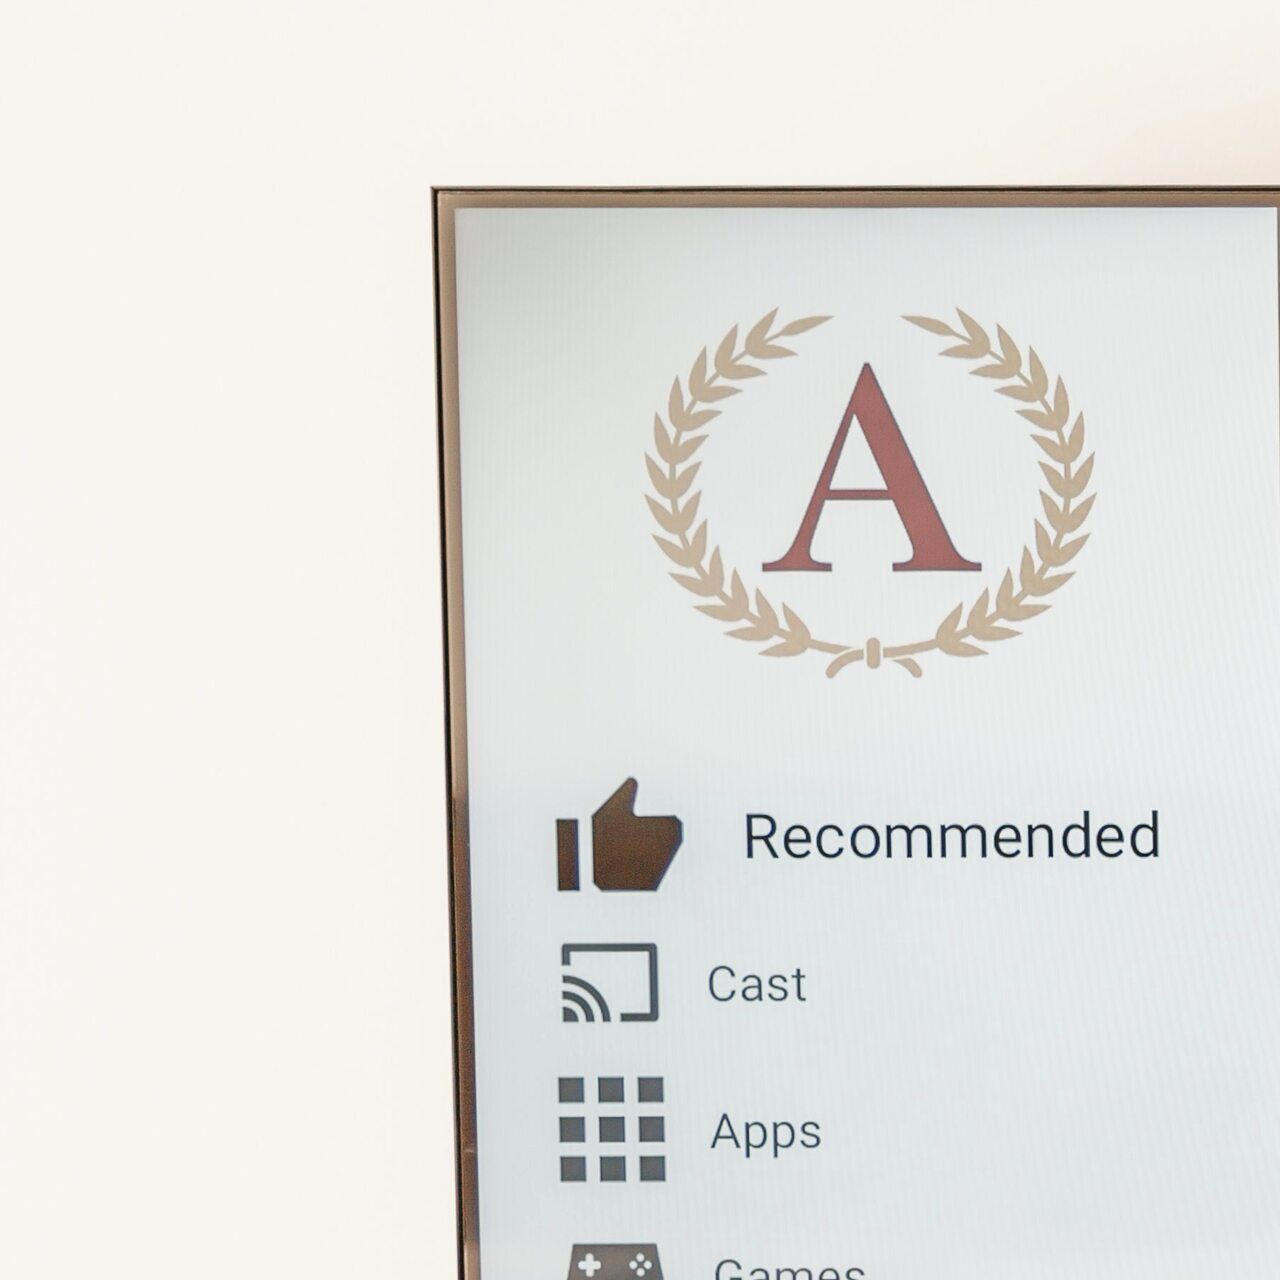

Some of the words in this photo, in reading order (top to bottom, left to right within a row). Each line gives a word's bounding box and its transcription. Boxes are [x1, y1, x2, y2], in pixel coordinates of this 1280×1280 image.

[761, 361, 983, 573] A
[746, 810, 1160, 860] Recommended
[707, 965, 807, 1003] Cast
[710, 1112, 822, 1159] Apps
